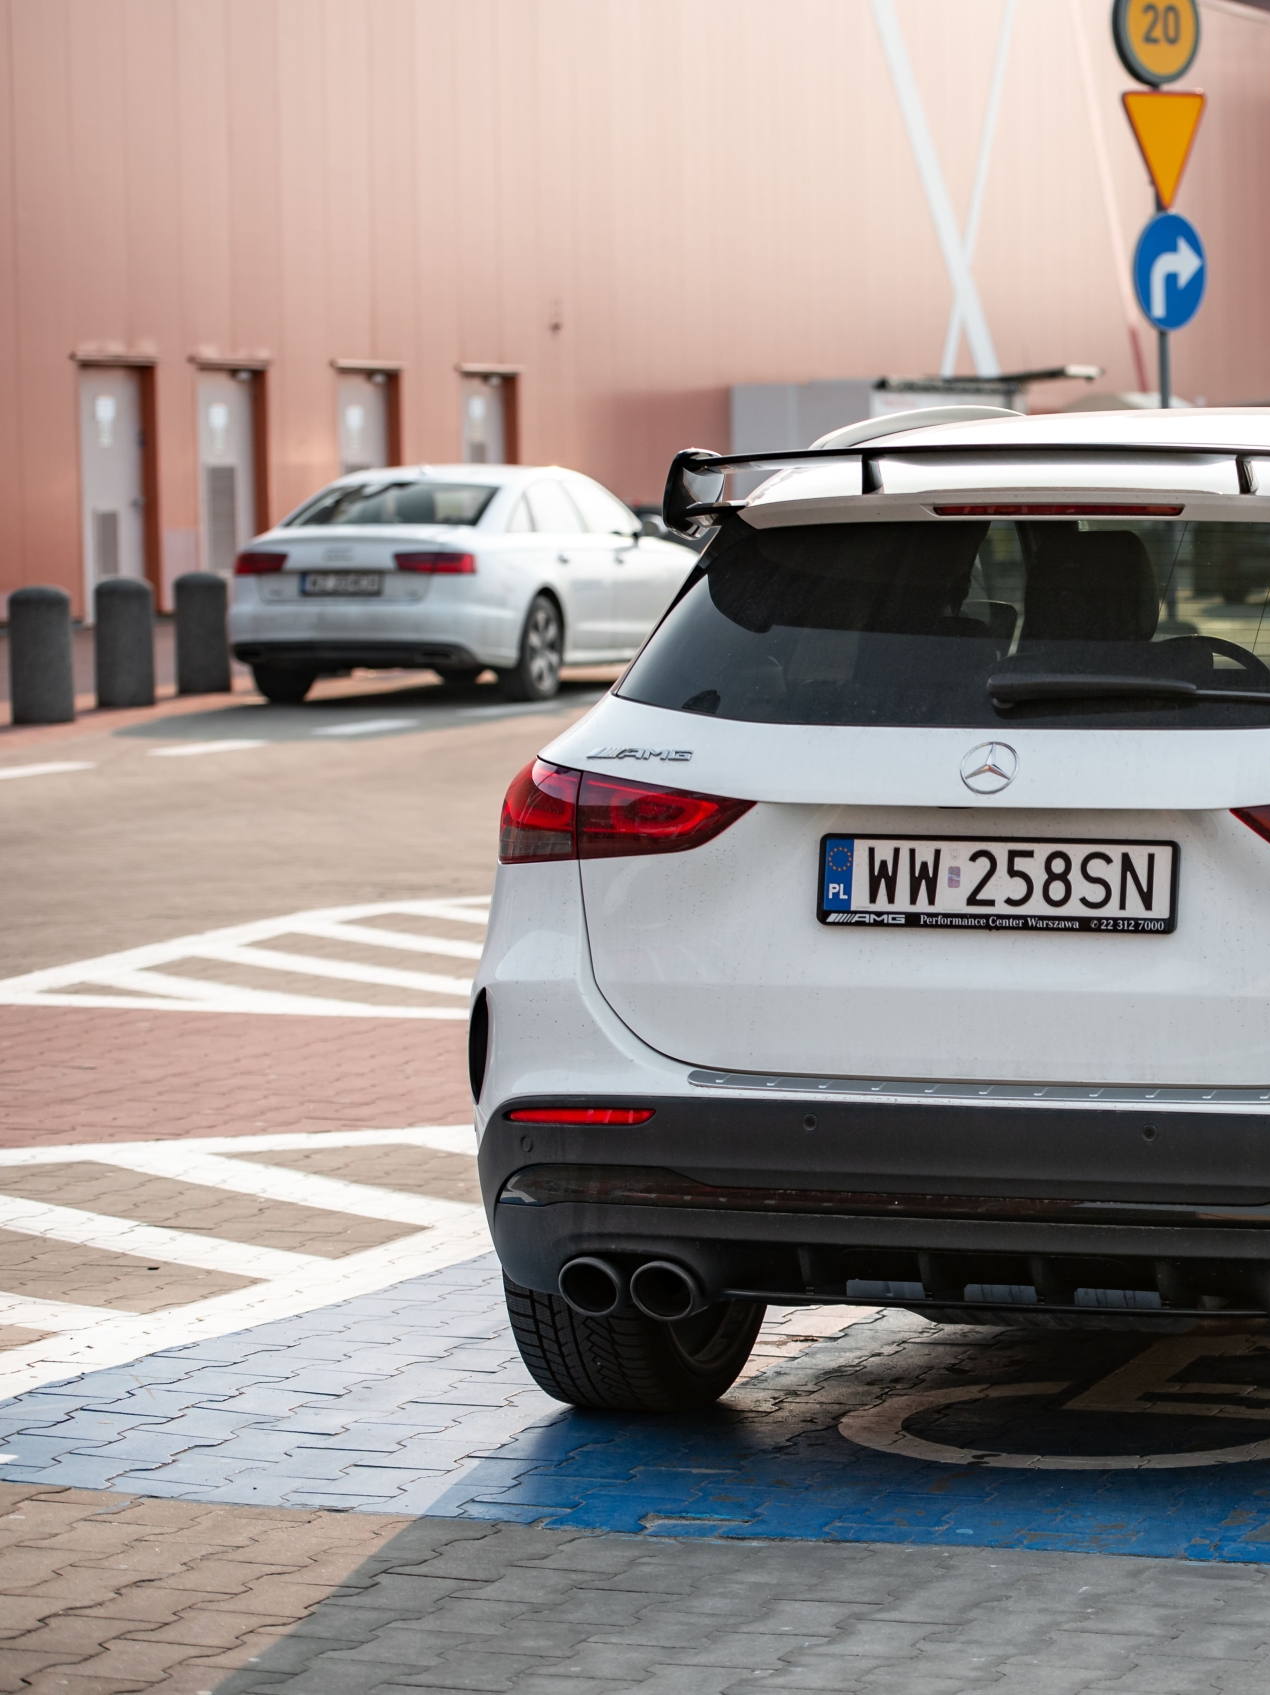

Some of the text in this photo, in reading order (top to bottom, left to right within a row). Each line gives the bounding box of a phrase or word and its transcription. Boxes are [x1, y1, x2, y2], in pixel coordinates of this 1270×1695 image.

[1143, 4, 1180, 45] 20
[614, 747, 693, 761] AMG
[868, 847, 1155, 911] WW 258SN
[828, 883, 849, 899] PL
[850, 914, 906, 924] AMG
[920, 914, 1079, 929] Performance Center Warszawa
[1100, 919, 1164, 931] 22 312 7000
